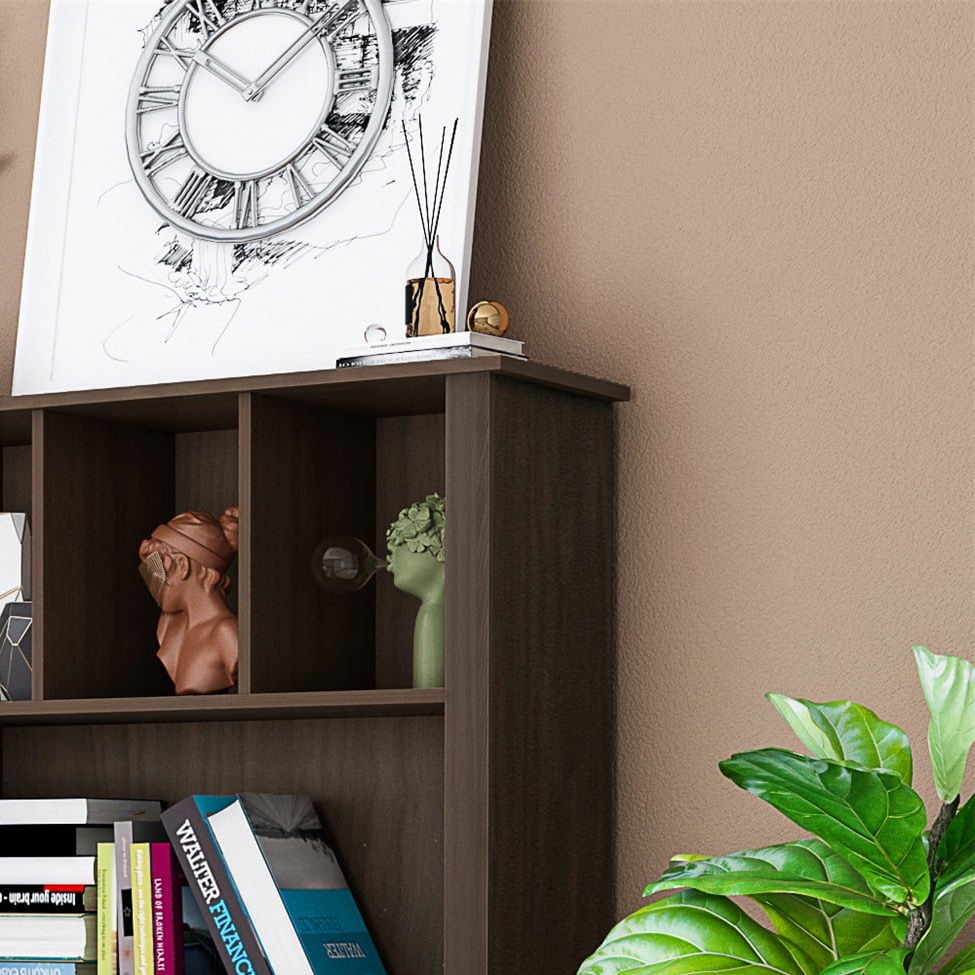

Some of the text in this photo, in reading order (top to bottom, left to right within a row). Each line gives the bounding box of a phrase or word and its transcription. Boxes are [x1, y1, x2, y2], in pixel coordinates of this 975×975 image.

[176, 819, 220, 905] WALTER
[9, 892, 30, 906] brain
[30, 889, 50, 905] your
[51, 892, 76, 906] Inside
[154, 878, 165, 971] LAND OF BROKEN HEARTS
[323, 942, 366, 959] WALTER
